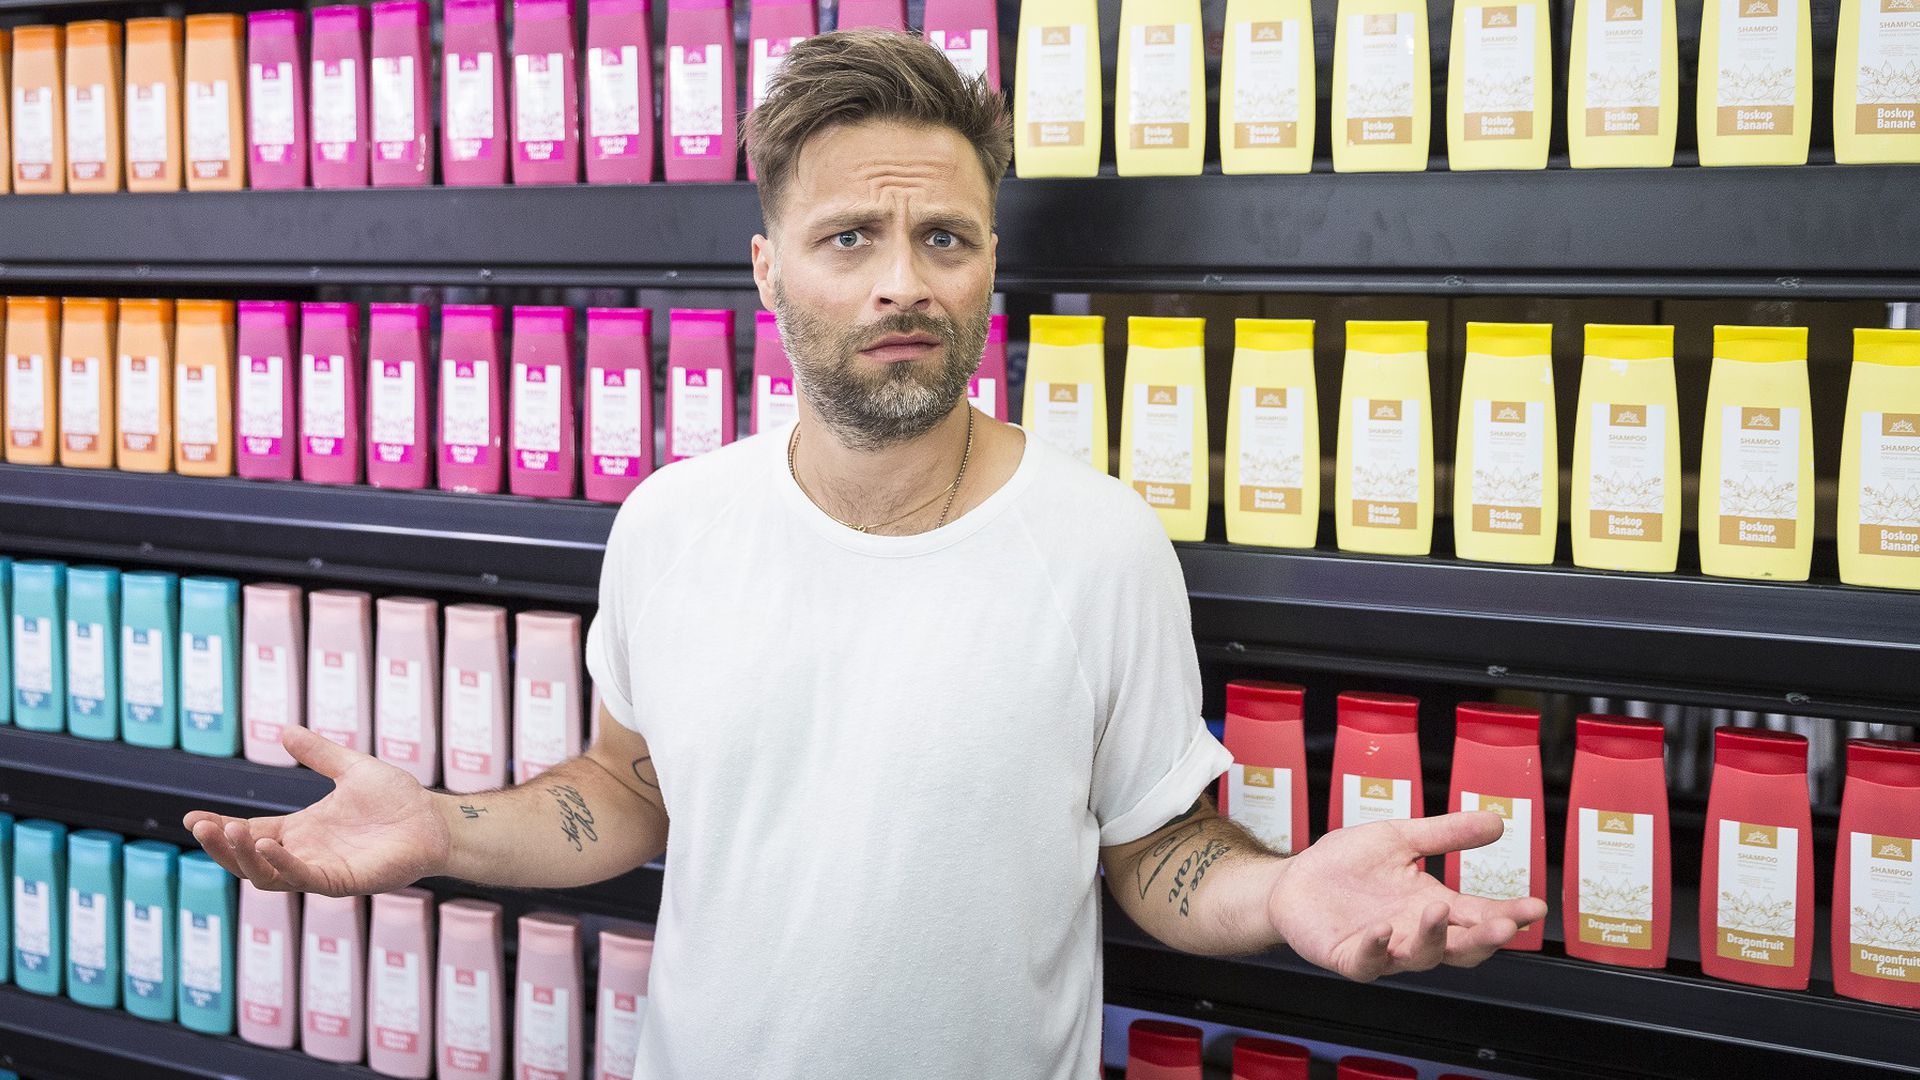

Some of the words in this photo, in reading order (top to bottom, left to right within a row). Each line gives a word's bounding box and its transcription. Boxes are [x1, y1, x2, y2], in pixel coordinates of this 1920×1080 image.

[1604, 29, 1643, 37] SHAMPOO
[1736, 25, 1778, 33] SHAMPOO
[1604, 110, 1639, 123] Boskop
[1737, 109, 1773, 122] Boskop
[1877, 107, 1914, 120] Boskop
[1363, 121, 1393, 133] Boskop
[1481, 115, 1514, 127] Boskop
[1604, 120, 1641, 131] Banane
[1737, 119, 1775, 131] Banane
[1877, 118, 1916, 129] Banane
[1249, 125, 1280, 137] Boskop
[1363, 130, 1396, 140] Banane
[1481, 125, 1515, 136] Banane
[1249, 134, 1281, 144] Banane
[1254, 489, 1284, 502] Boskop
[1254, 499, 1286, 509] Banane
[1368, 504, 1399, 516] Boskop
[1368, 513, 1401, 525] Banane
[1489, 509, 1522, 522] Boskop
[1608, 514, 1642, 529] Boskop
[1489, 518, 1523, 530] Banane
[1739, 520, 1775, 535] Boskop
[1608, 524, 1645, 537] Banane
[1739, 530, 1777, 543] Banane
[1881, 530, 1918, 544] Boskop
[1881, 539, 1920, 552] Banane
[1597, 839, 1635, 848] SHAMPOO
[1737, 852, 1777, 863] SHAMPOO
[1871, 866, 1912, 877] SHAMPOO
[1587, 918, 1643, 934] Dragonfruit
[1602, 931, 1629, 944] Frank
[1727, 933, 1784, 951] Dragonfruit
[1741, 945, 1769, 961] Frank
[1861, 949, 1920, 967] Dragonfruit
[1876, 963, 1906, 977] Frank
